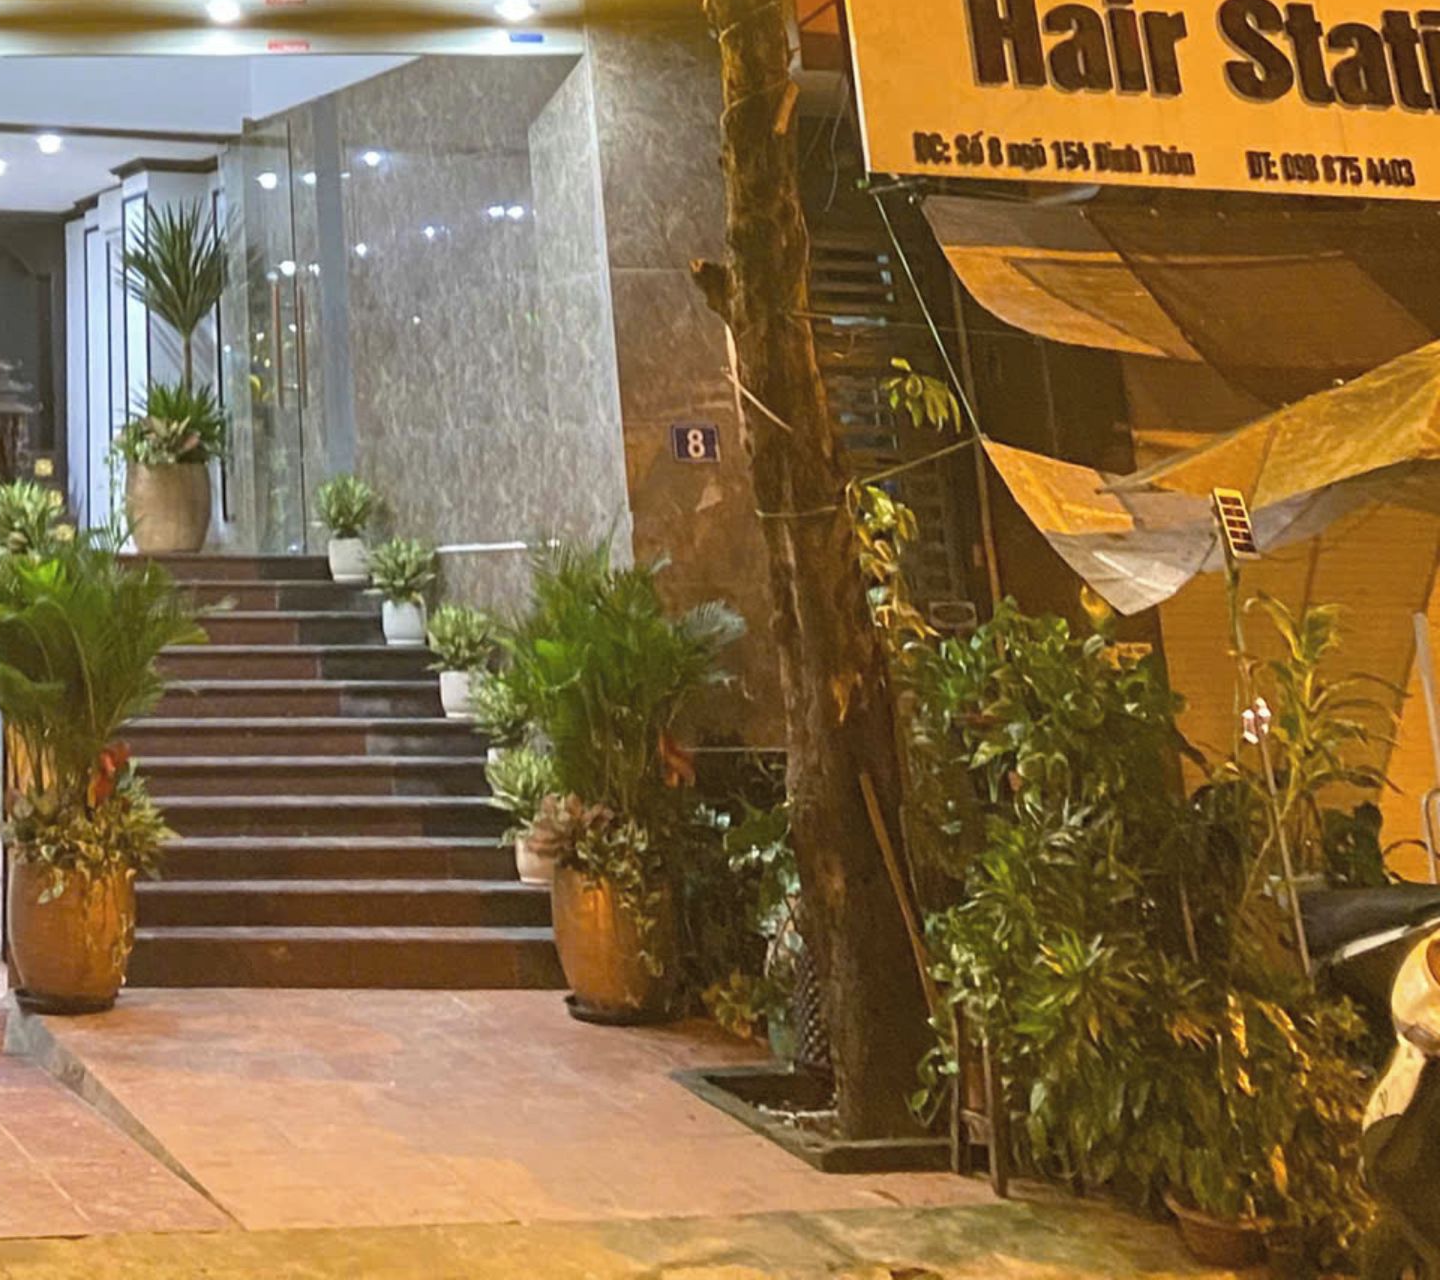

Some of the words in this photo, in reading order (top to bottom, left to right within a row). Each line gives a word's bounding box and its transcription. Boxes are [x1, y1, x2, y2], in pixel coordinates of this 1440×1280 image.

[954, 129, 985, 167] Số
[987, 135, 1004, 169] 8
[1051, 140, 1092, 172] 154
[1321, 153, 1363, 186] 875
[1365, 156, 1417, 187] 4403
[686, 428, 706, 459] 8
